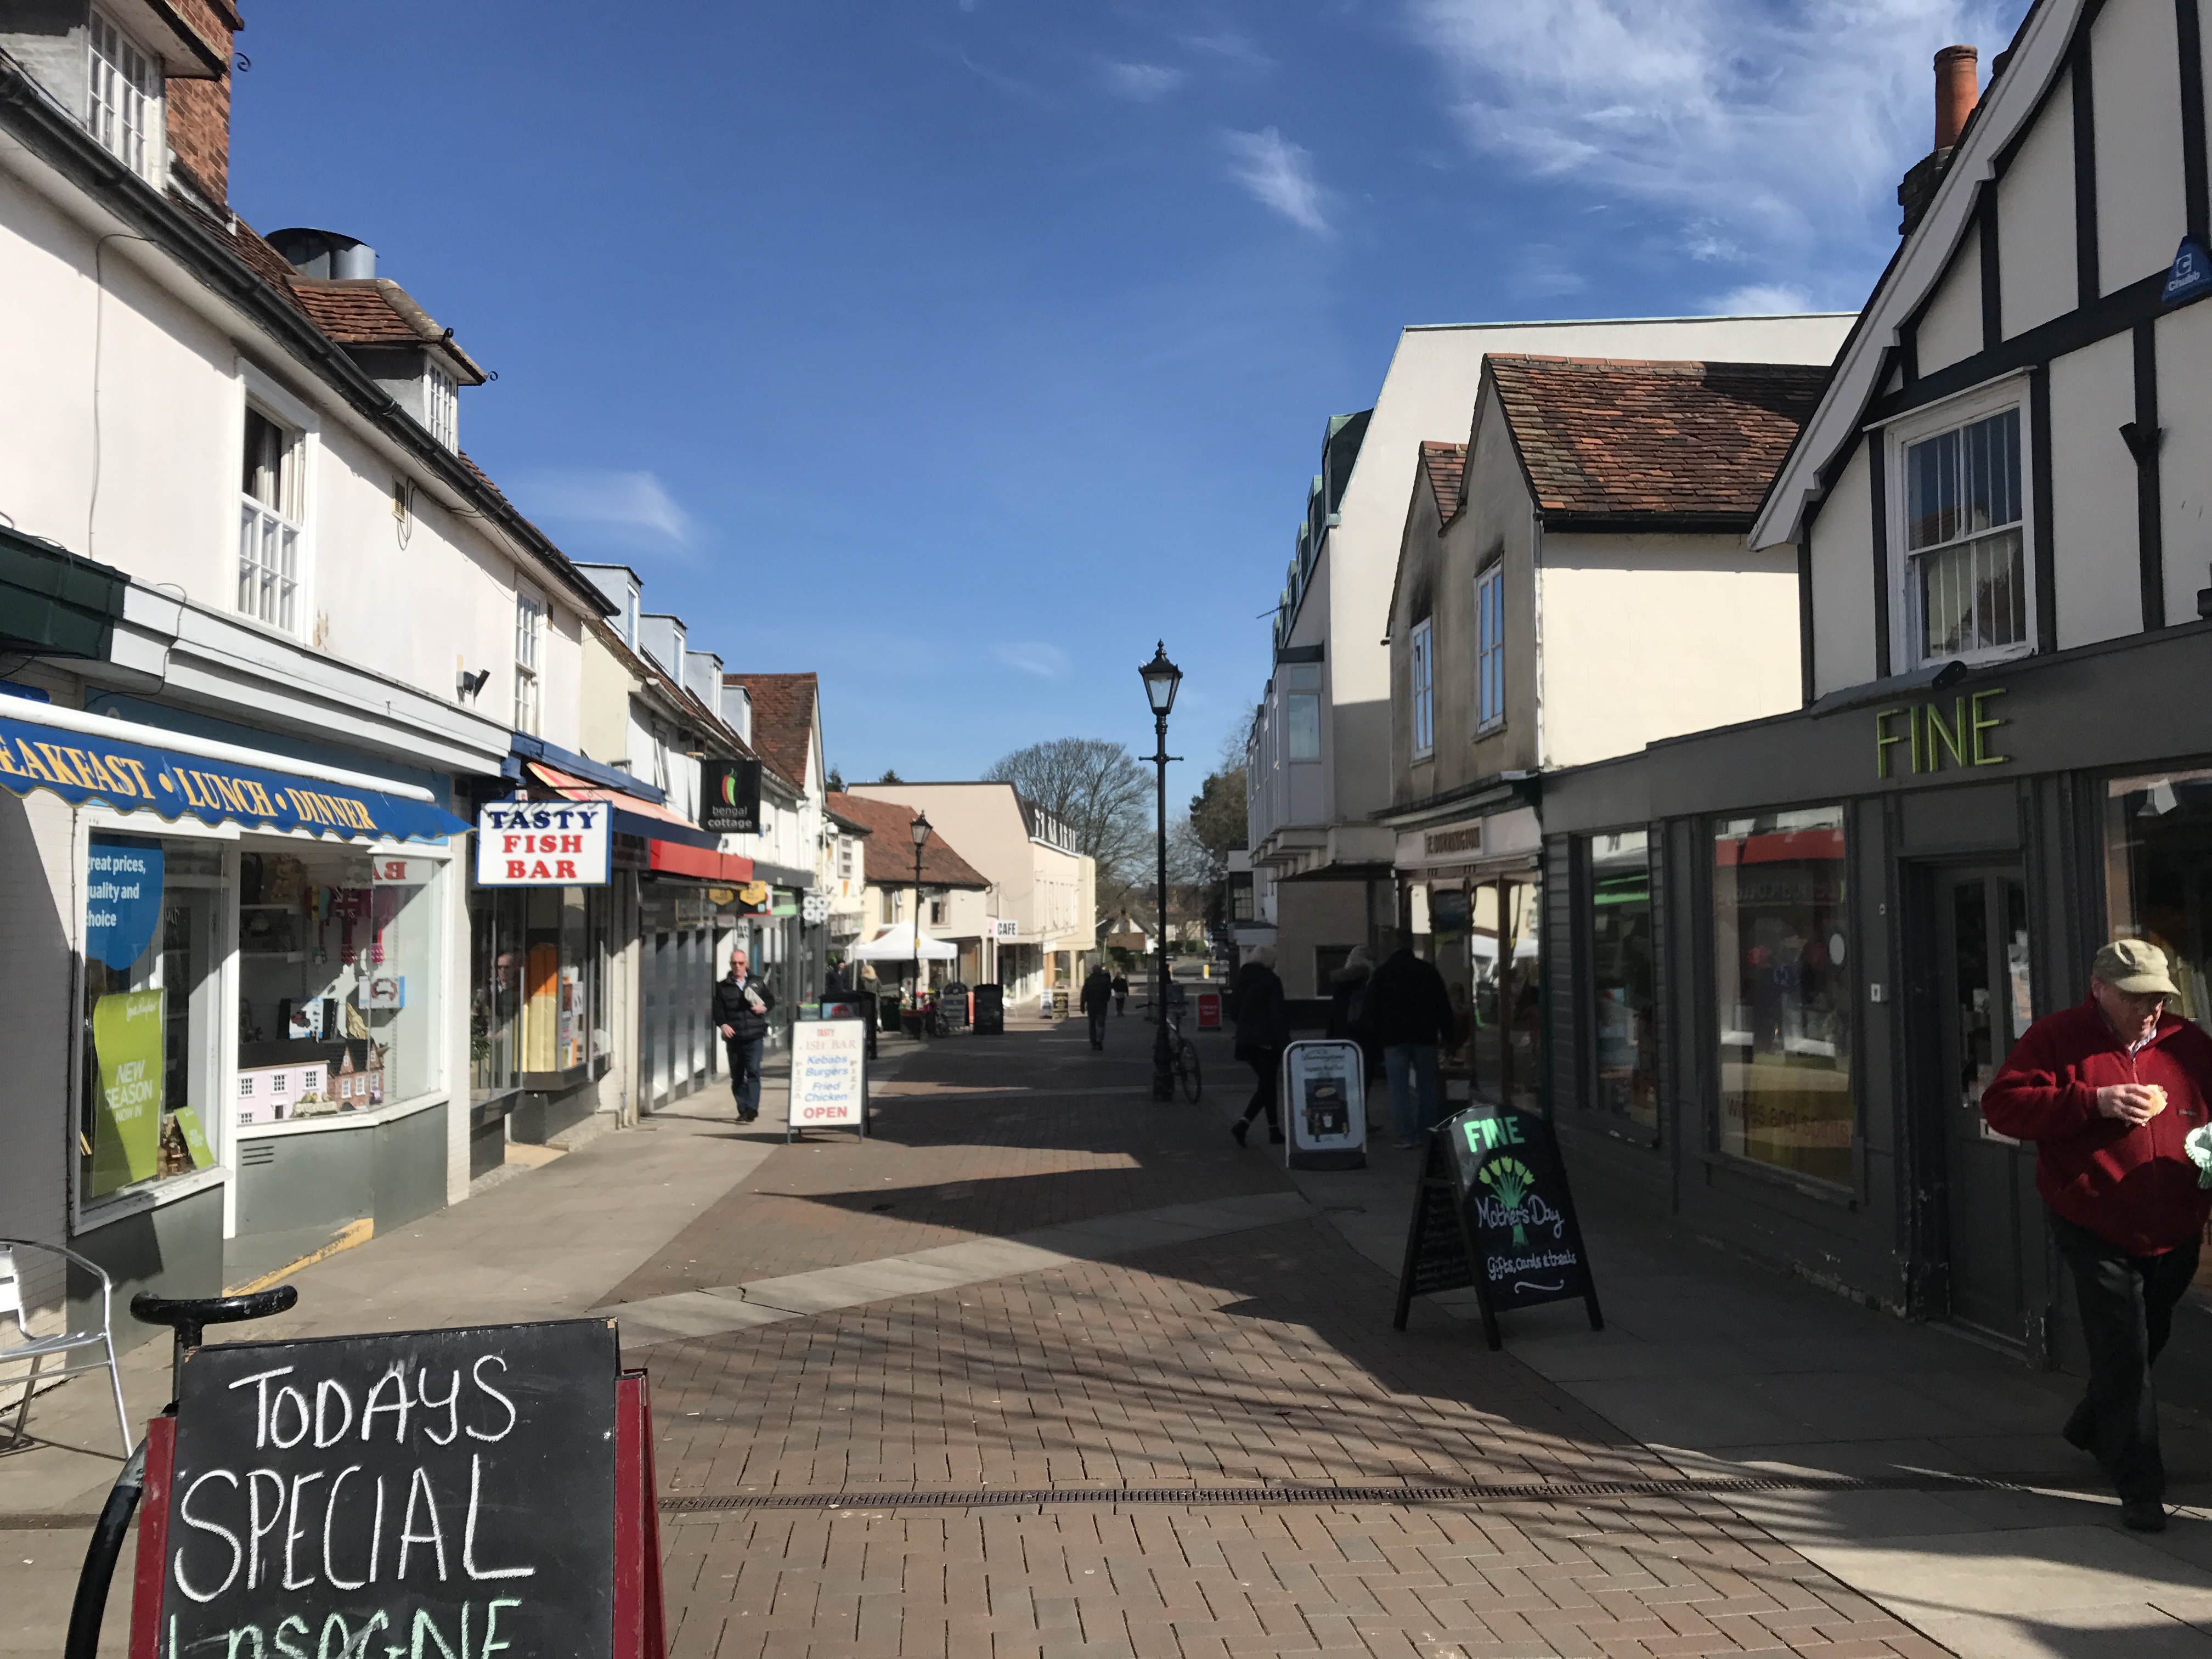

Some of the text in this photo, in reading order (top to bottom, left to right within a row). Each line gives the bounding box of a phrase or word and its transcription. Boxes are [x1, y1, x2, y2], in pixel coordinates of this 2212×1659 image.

[2168, 270, 2200, 291] Chubb
[1876, 688, 2009, 778] FINE
[173, 767, 278, 817] LUNCH
[284, 787, 378, 831] DINNER
[488, 810, 599, 829] TASTY
[712, 805, 748, 817] bengal
[708, 818, 752, 830] cottage
[502, 834, 583, 854] FISH
[113, 855, 146, 876] prices,
[505, 859, 578, 879] BAR
[121, 882, 139, 900] and
[997, 923, 1015, 935] CAFE
[831, 1040, 856, 1049] BAR
[807, 1055, 848, 1064] Kebabs
[116, 1060, 145, 1086] NEW
[805, 1067, 849, 1078] Burgers
[105, 1080, 153, 1110] SEASON
[812, 1081, 841, 1091] Fried
[804, 1092, 848, 1102] Chicken
[115, 1104, 142, 1124] NOW IN
[803, 1106, 848, 1119] OPEN
[1463, 1116, 1526, 1153] FINE
[1527, 1194, 1565, 1239] Day
[228, 1353, 516, 1450] TODAYS
[173, 1452, 535, 1602] SPECIAL
